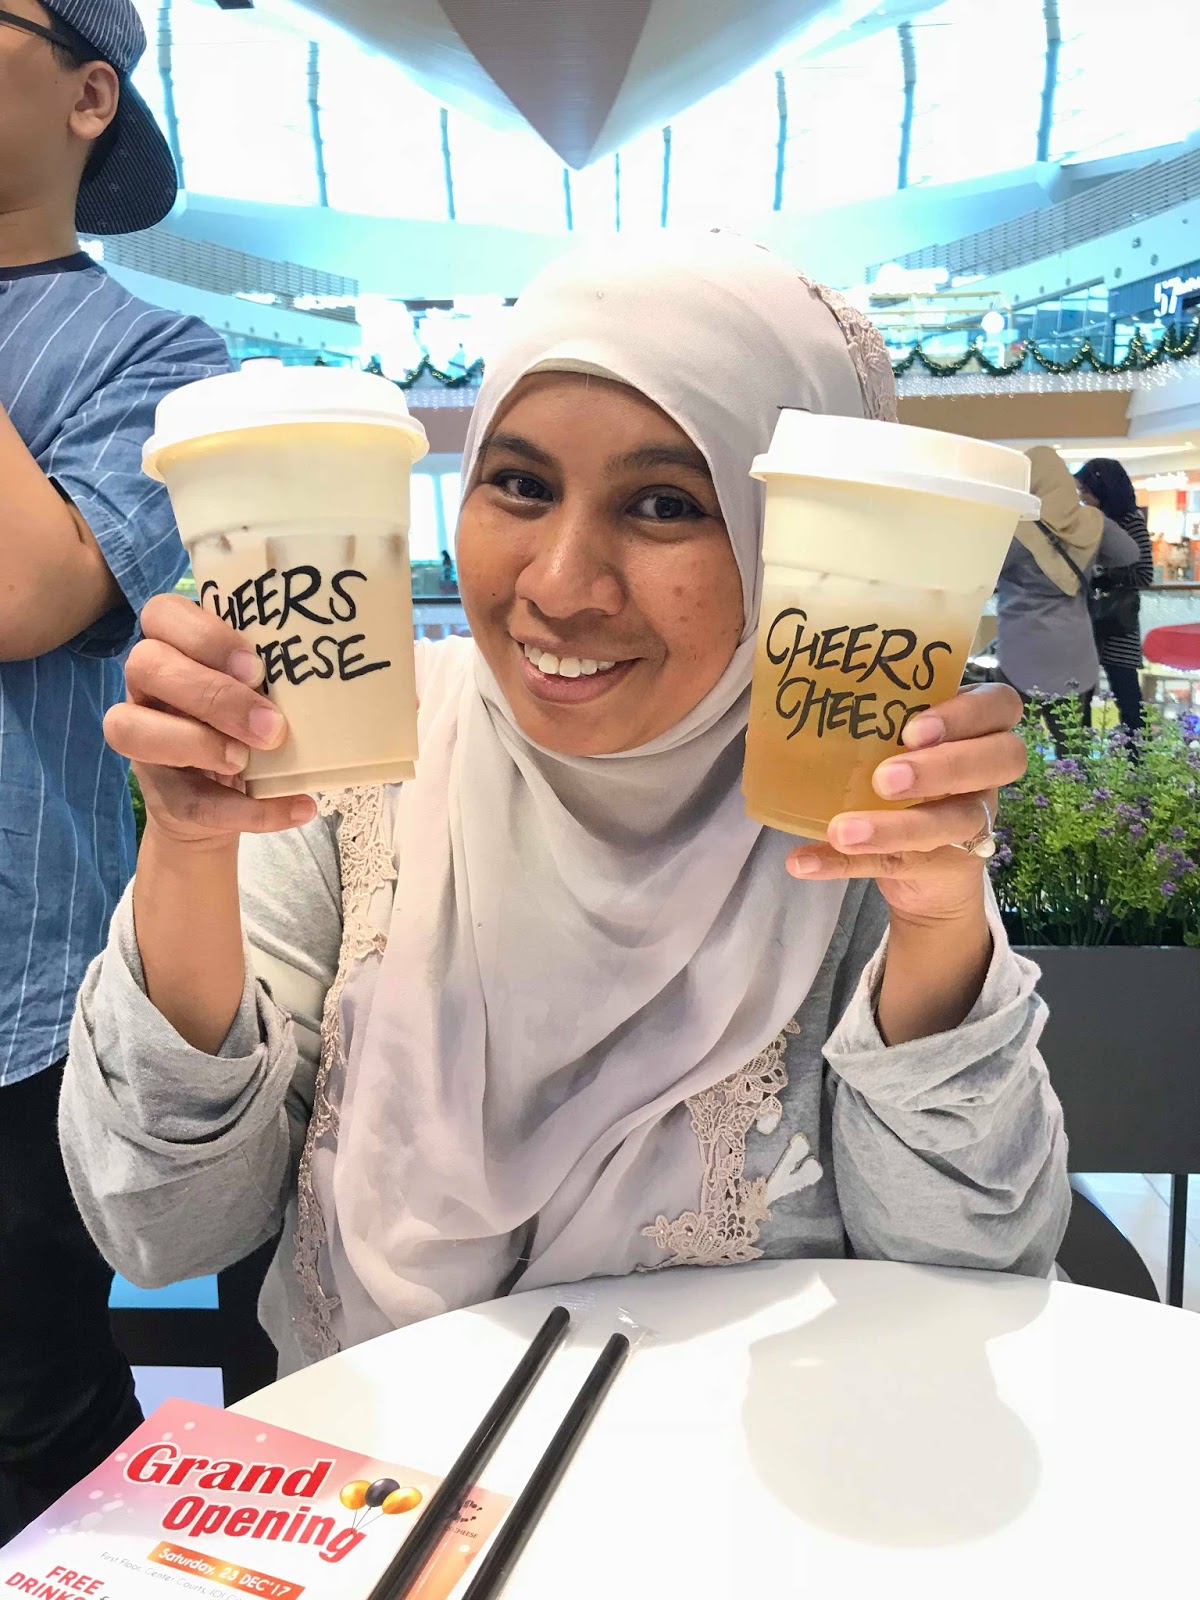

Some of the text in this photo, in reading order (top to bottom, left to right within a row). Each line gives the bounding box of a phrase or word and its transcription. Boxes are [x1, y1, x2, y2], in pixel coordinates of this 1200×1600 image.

[256, 634, 391, 694] EESE
[766, 607, 952, 690] CHEERS
[126, 1443, 334, 1499] Grand
[161, 1495, 368, 1562] Opening
[45, 1565, 105, 1595] FREE
[100, 1551, 119, 1563] First
[145, 1567, 175, 1582] Center
[158, 1547, 216, 1576] Saturday,
[5, 1571, 87, 1600] DRINK
